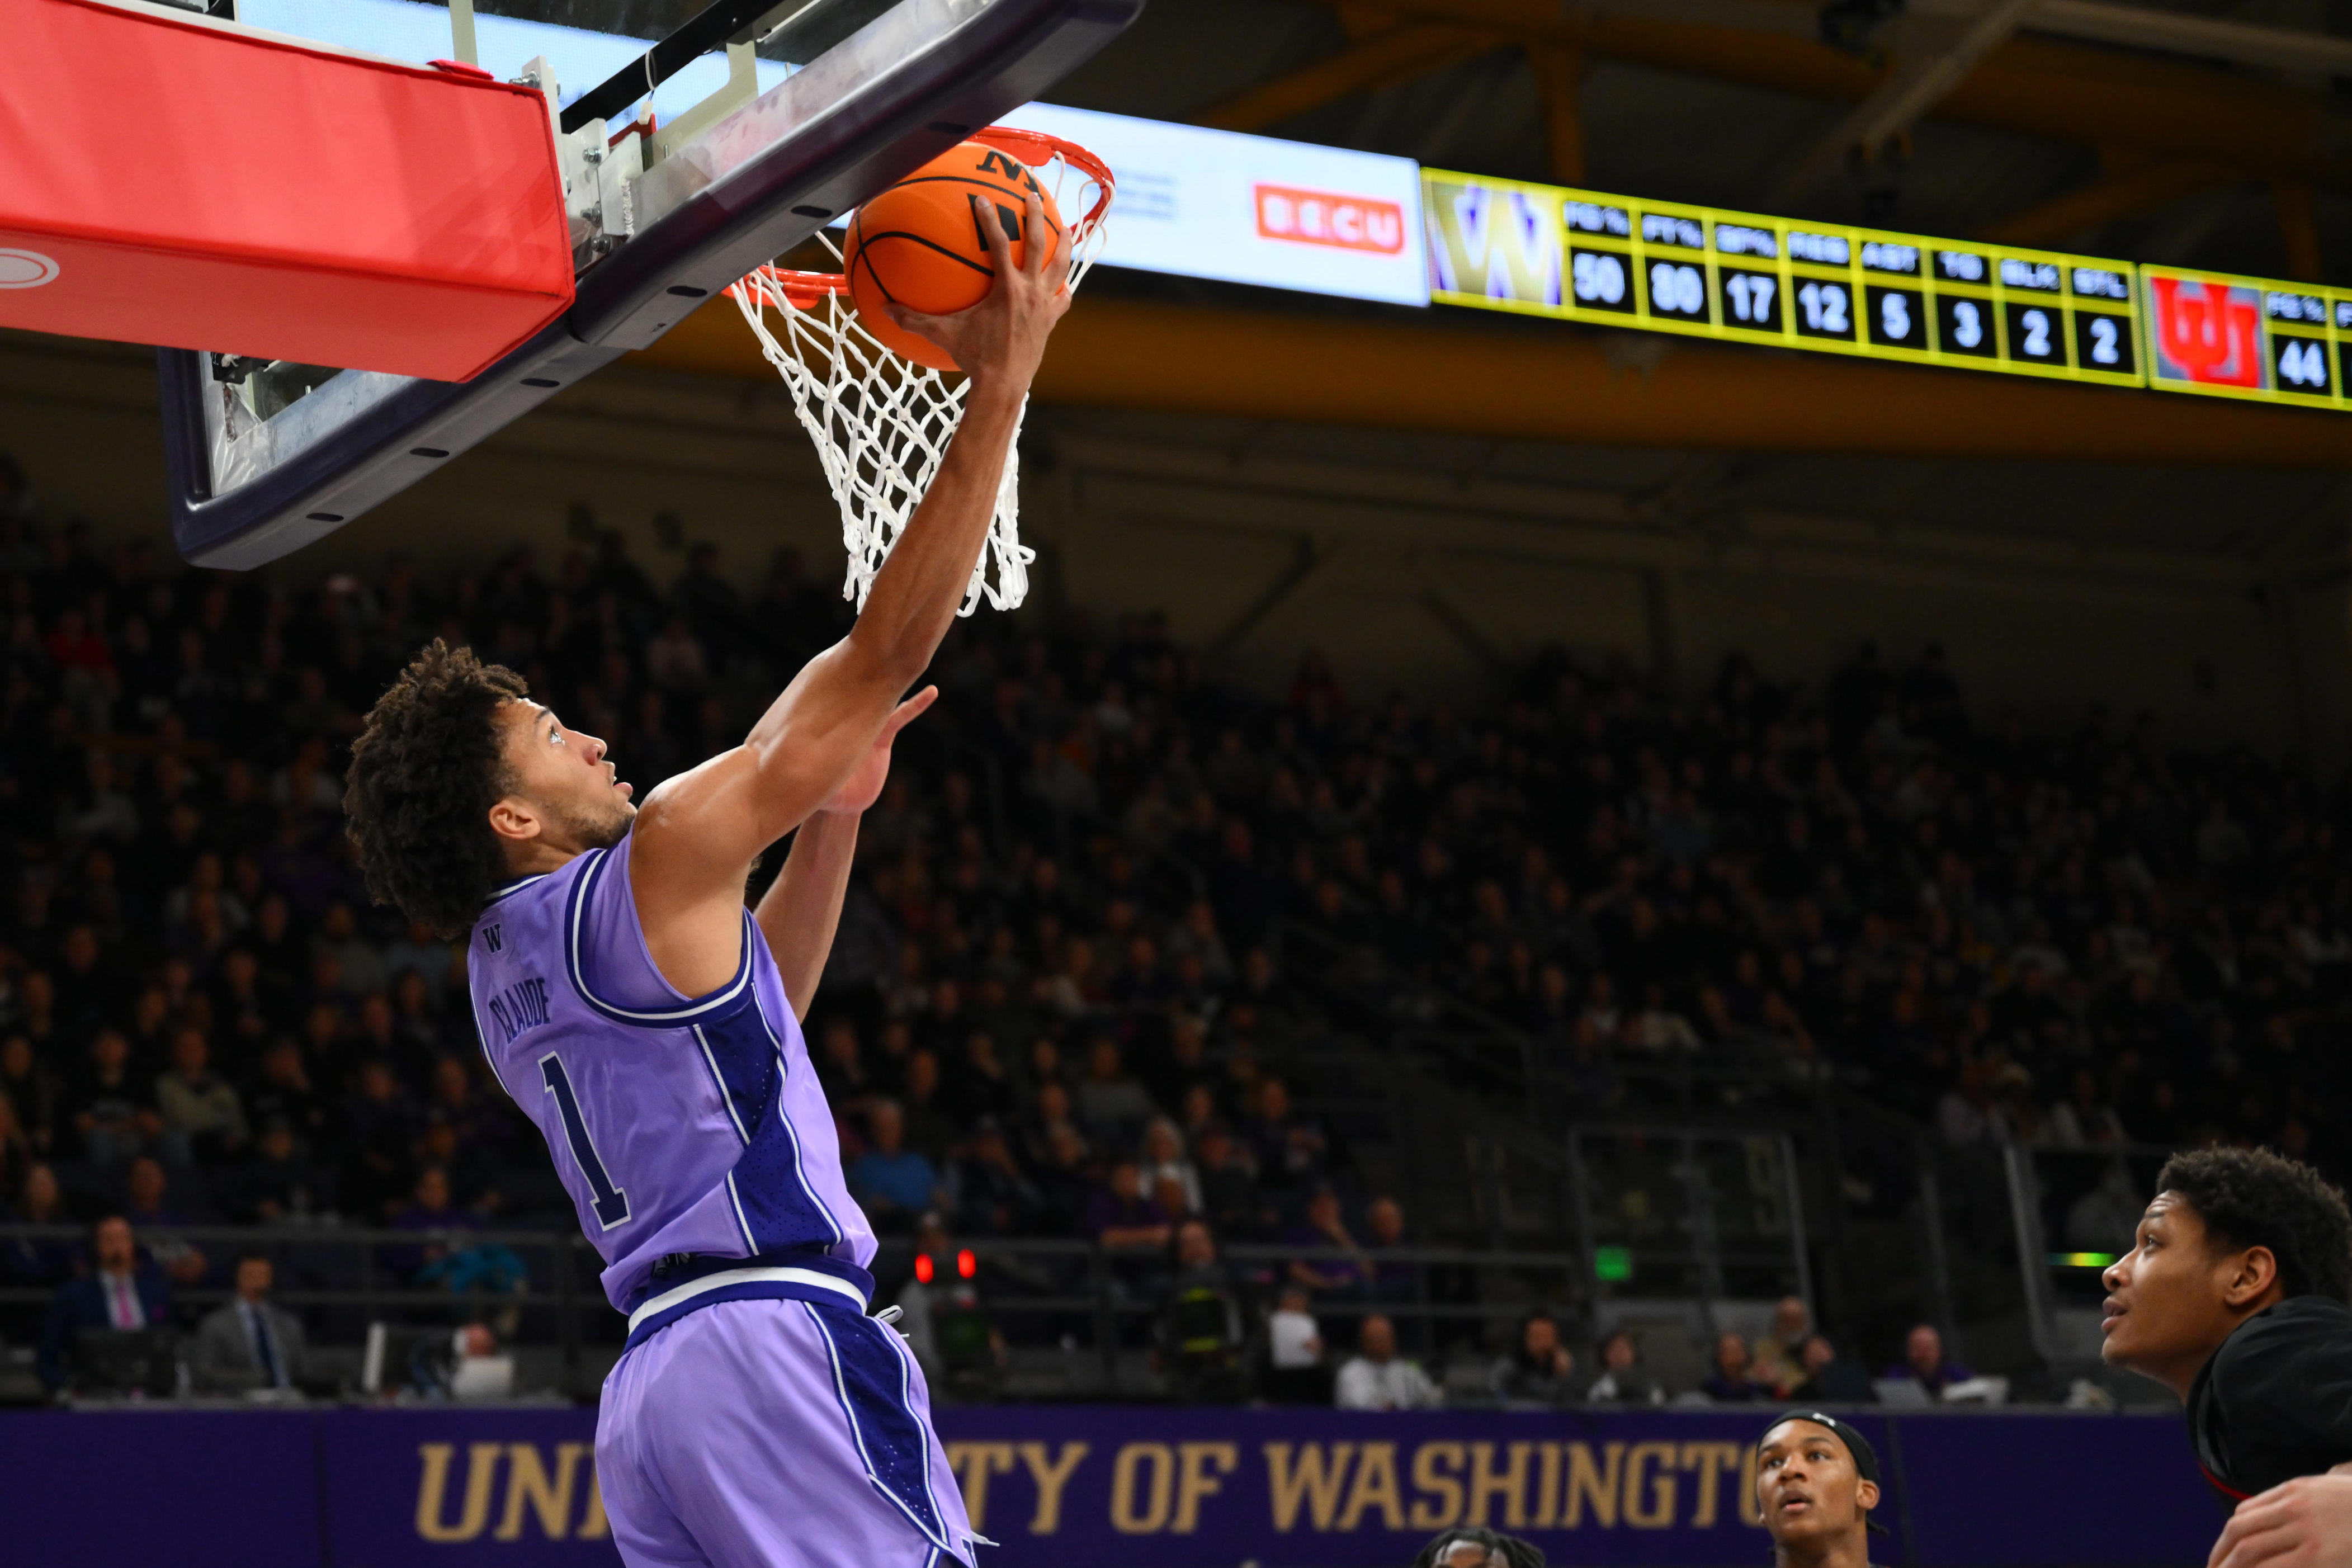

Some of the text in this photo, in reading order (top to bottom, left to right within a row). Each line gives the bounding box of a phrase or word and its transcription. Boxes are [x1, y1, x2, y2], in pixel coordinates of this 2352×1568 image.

[1574, 253, 1625, 304] 50
[1726, 273, 1777, 323] 17
[1798, 282, 1850, 332] 12
[1882, 292, 1911, 339] 5
[1953, 301, 1983, 348] 3
[2021, 309, 2052, 356] 2
[2090, 318, 2119, 364] 2
[2279, 339, 2327, 388] 44
[482, 923, 502, 954] W
[488, 977, 551, 1045] CLAUDE
[537, 1051, 631, 1232] 1
[1108, 1441, 1238, 1535] OF
[1264, 1441, 1773, 1531] WASHINGT
